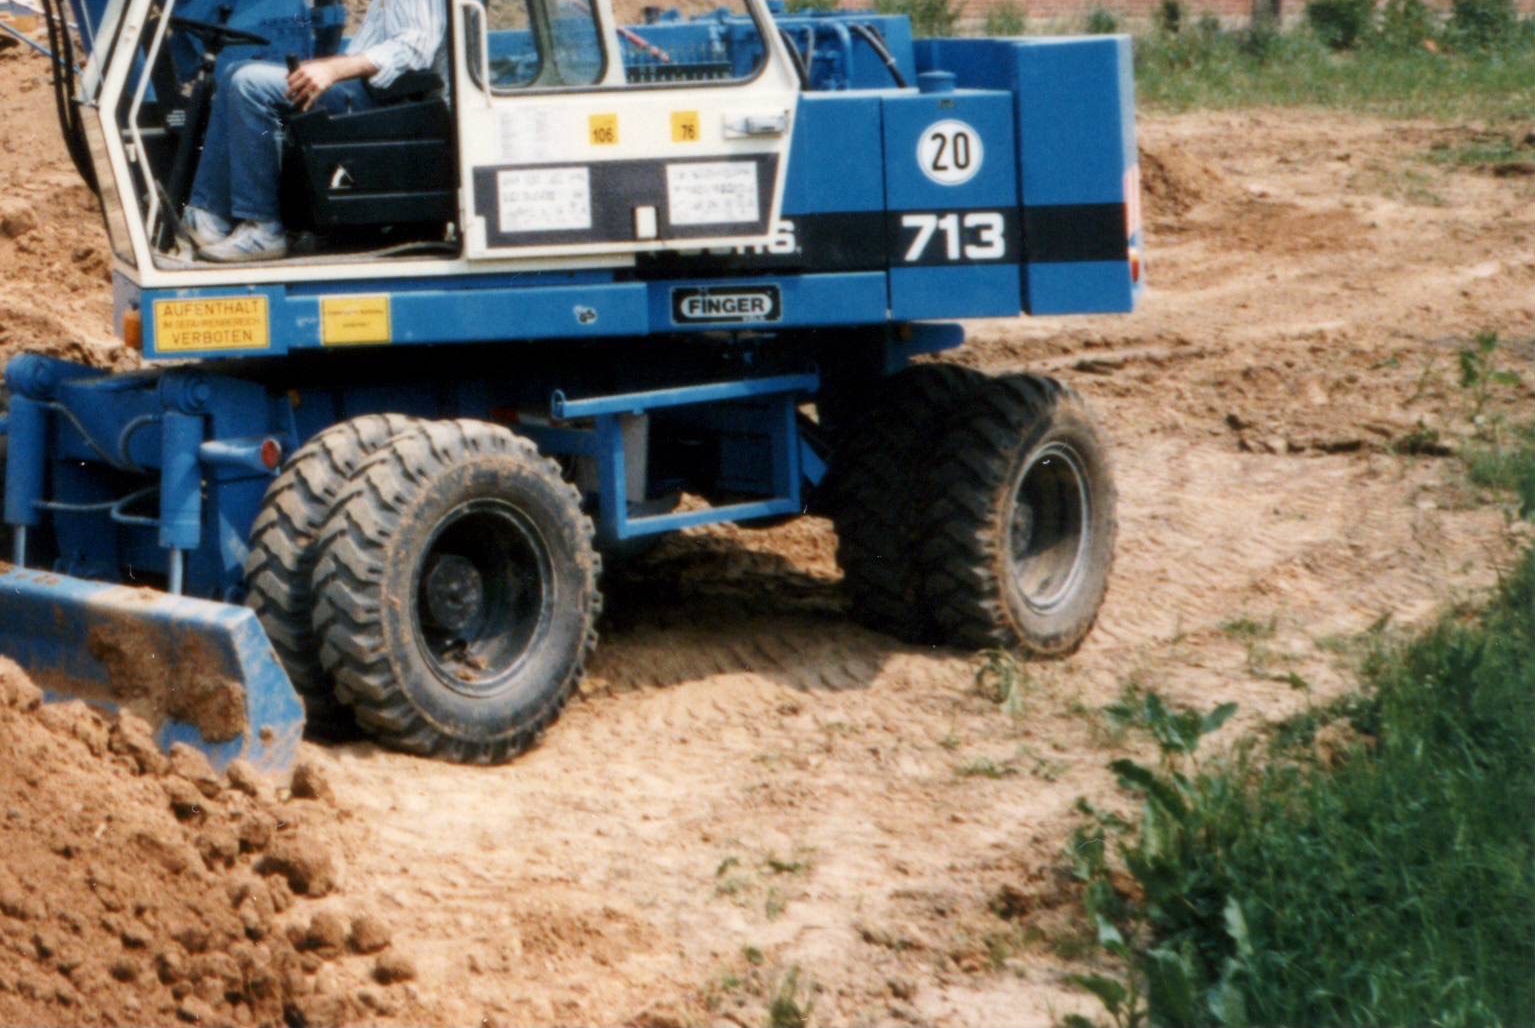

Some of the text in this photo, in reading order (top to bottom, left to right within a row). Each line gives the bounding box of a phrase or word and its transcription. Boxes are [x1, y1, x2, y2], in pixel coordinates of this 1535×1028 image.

[593, 126, 614, 143] 106
[931, 132, 970, 171] 20
[901, 212, 1005, 261] 713
[164, 300, 259, 317] AUFENTHALT
[688, 297, 765, 314] FINGER
[172, 329, 253, 345] VERBOTEN
